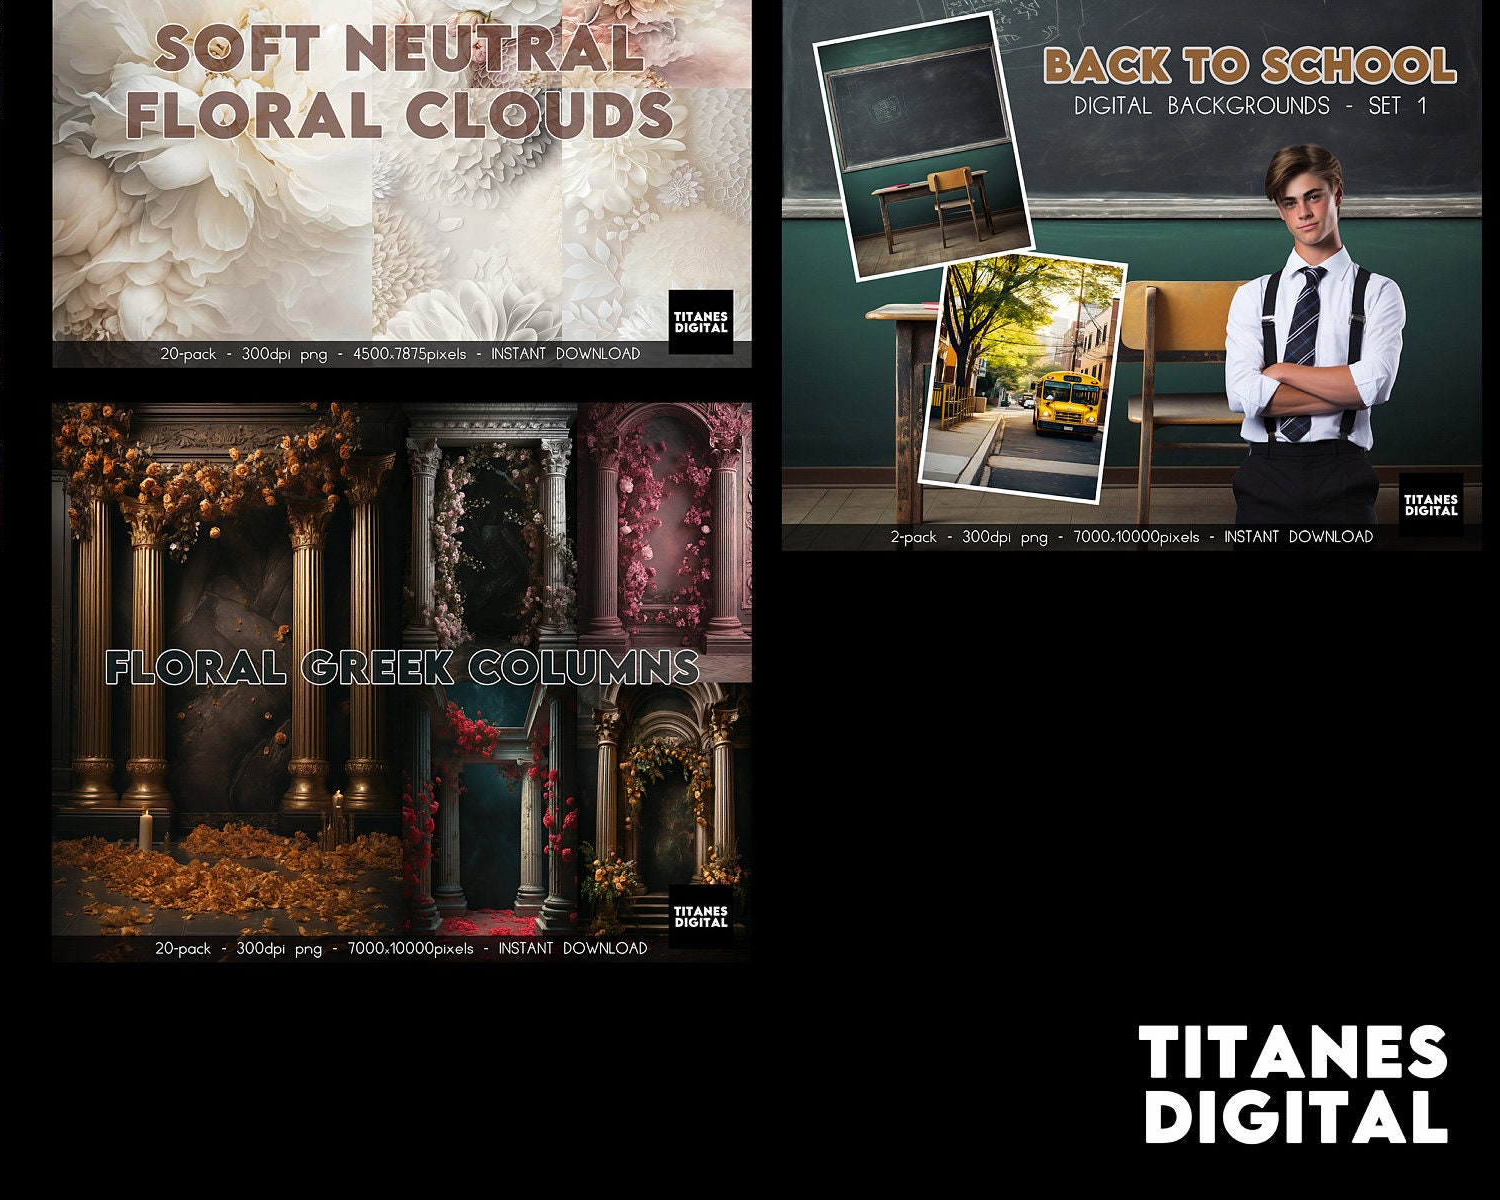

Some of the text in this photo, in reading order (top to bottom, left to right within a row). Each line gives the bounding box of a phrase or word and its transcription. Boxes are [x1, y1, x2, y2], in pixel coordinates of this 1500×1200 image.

[154, 23, 645, 74] SOFT NEUTRAL
[1043, 45, 1458, 86] BACK TO SCHOOL
[1075, 96, 1427, 115] DIGITAL BACKGROUNDS SET 1
[125, 90, 675, 141] FLORAL CLOUDS
[673, 311, 728, 322] TITANES
[674, 322, 729, 333] DIGITAL
[160, 346, 217, 364] 20-pack
[242, 346, 291, 364] 300dpi
[300, 351, 328, 364] png
[491, 346, 547, 360] INSTANT
[556, 346, 641, 361] DOWNLOAD
[1403, 494, 1458, 505] TITANES
[1404, 505, 1459, 516] DIGITAL
[890, 529, 937, 547] 2-pack
[962, 529, 1011, 547] 300dpi
[1021, 534, 1048, 547] png
[1224, 529, 1280, 543] INSTANT
[1289, 529, 1374, 543] DOWNLOAD
[105, 648, 700, 686] FLORAL GREEK COLUMNS
[673, 906, 728, 917] TITANES
[674, 917, 729, 928] DIGITAL
[155, 941, 212, 959] 20-pack
[236, 941, 285, 959] 300dpi
[295, 945, 322, 959] png
[499, 941, 554, 955] INSTANT
[563, 941, 648, 955] DOWNLOAD
[1139, 1025, 1447, 1078] TITANES
[1146, 1090, 1447, 1144] DIGITAL
